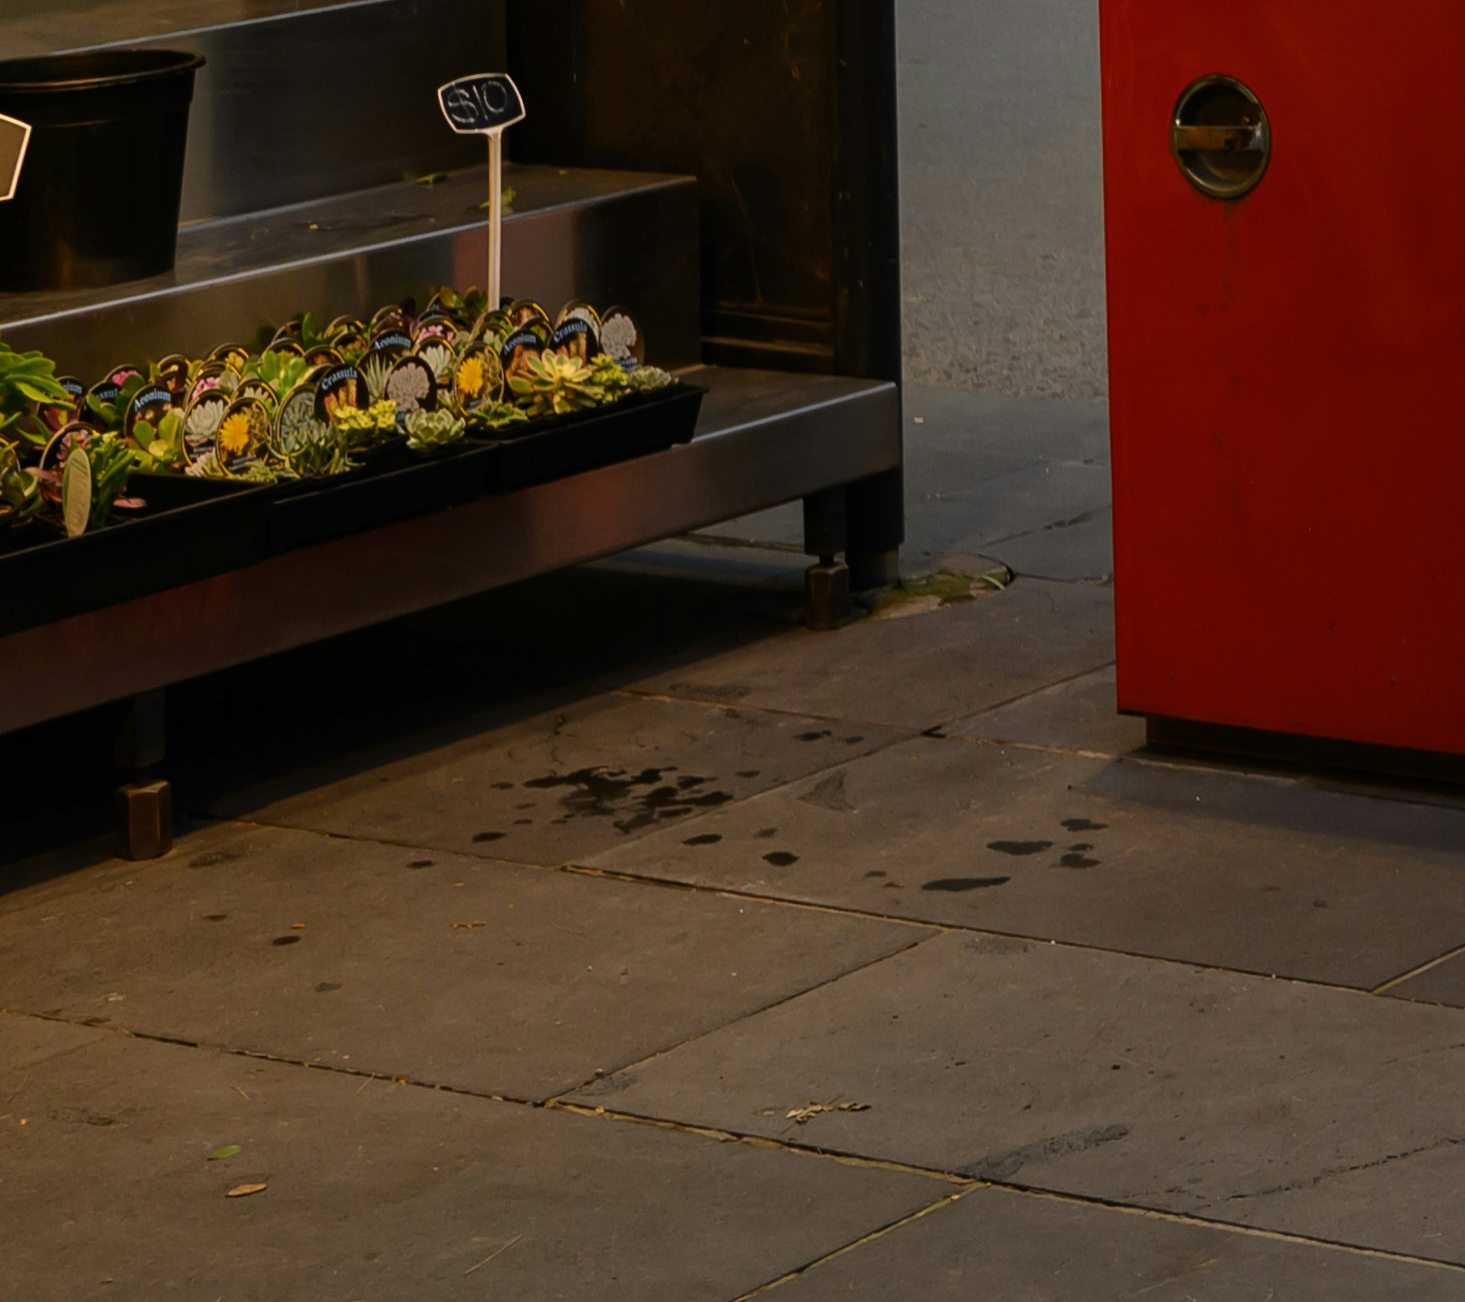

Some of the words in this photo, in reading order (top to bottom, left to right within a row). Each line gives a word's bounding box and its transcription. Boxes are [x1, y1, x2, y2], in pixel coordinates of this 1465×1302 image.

[447, 80, 508, 124] $10
[320, 366, 359, 391] Crassula
[132, 387, 172, 412] Aeonium
